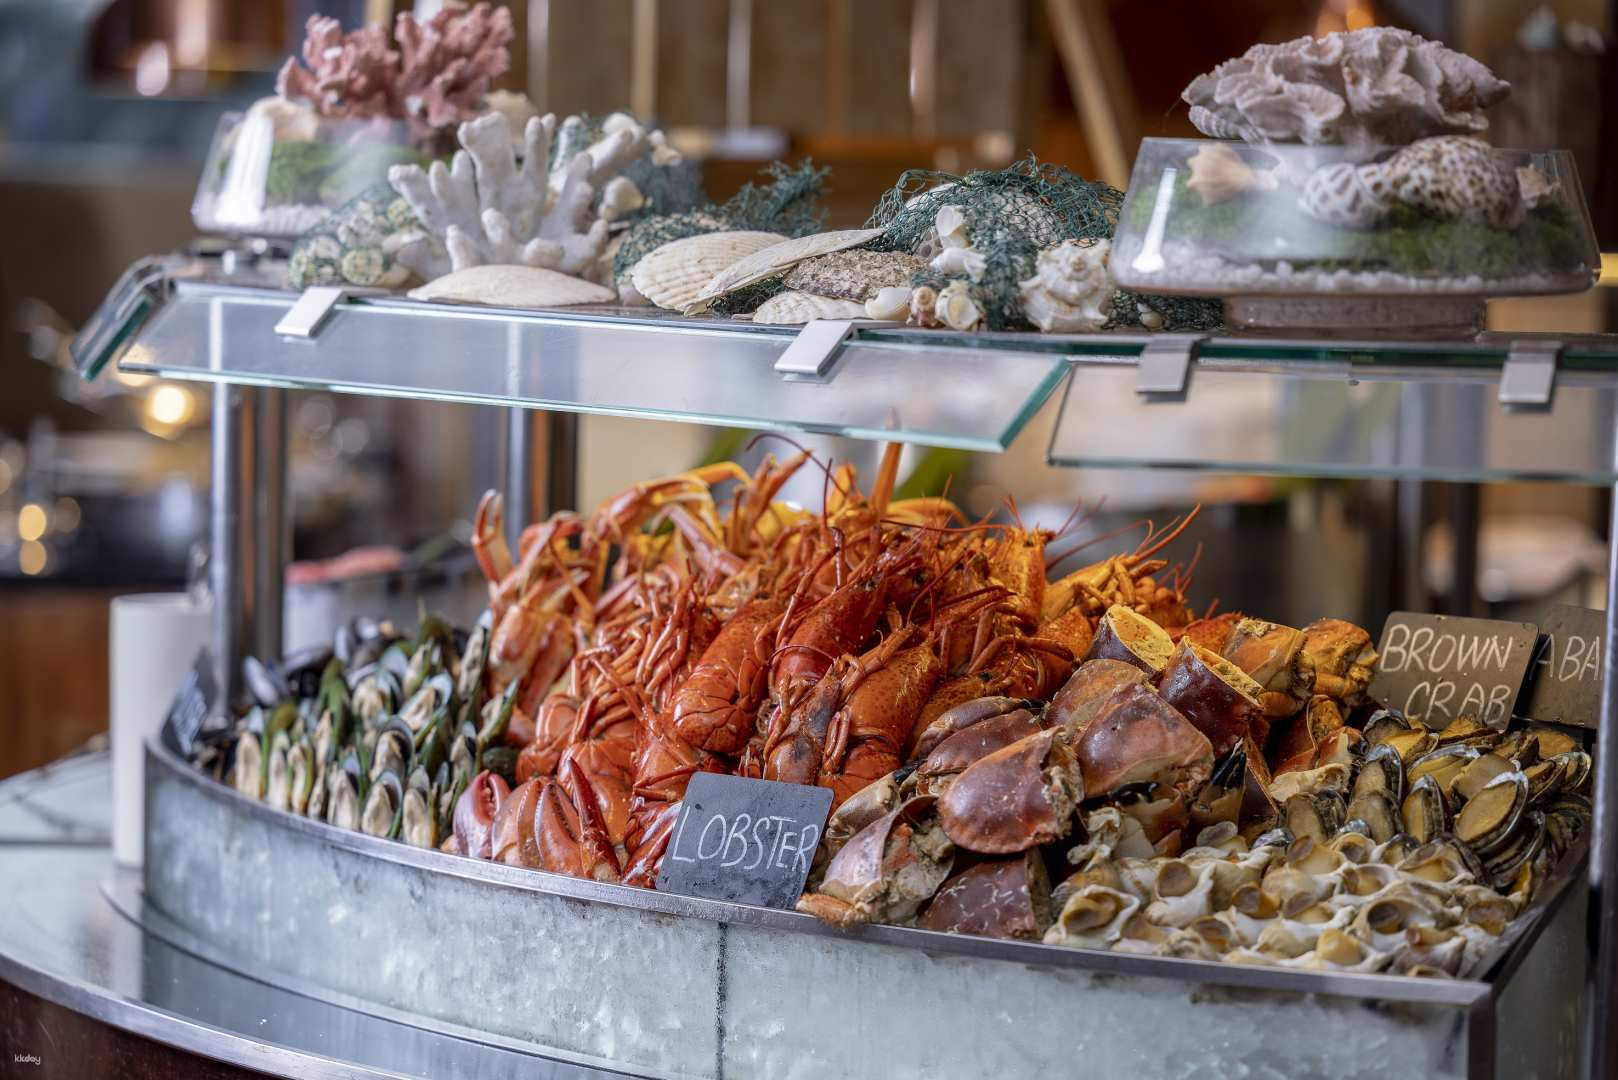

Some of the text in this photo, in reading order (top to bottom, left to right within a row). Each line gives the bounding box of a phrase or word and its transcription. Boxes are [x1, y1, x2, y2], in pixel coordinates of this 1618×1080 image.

[1379, 624, 1513, 673] BROWN
[1404, 681, 1511, 725] CRAB
[672, 805, 819, 873] LOBSTER
